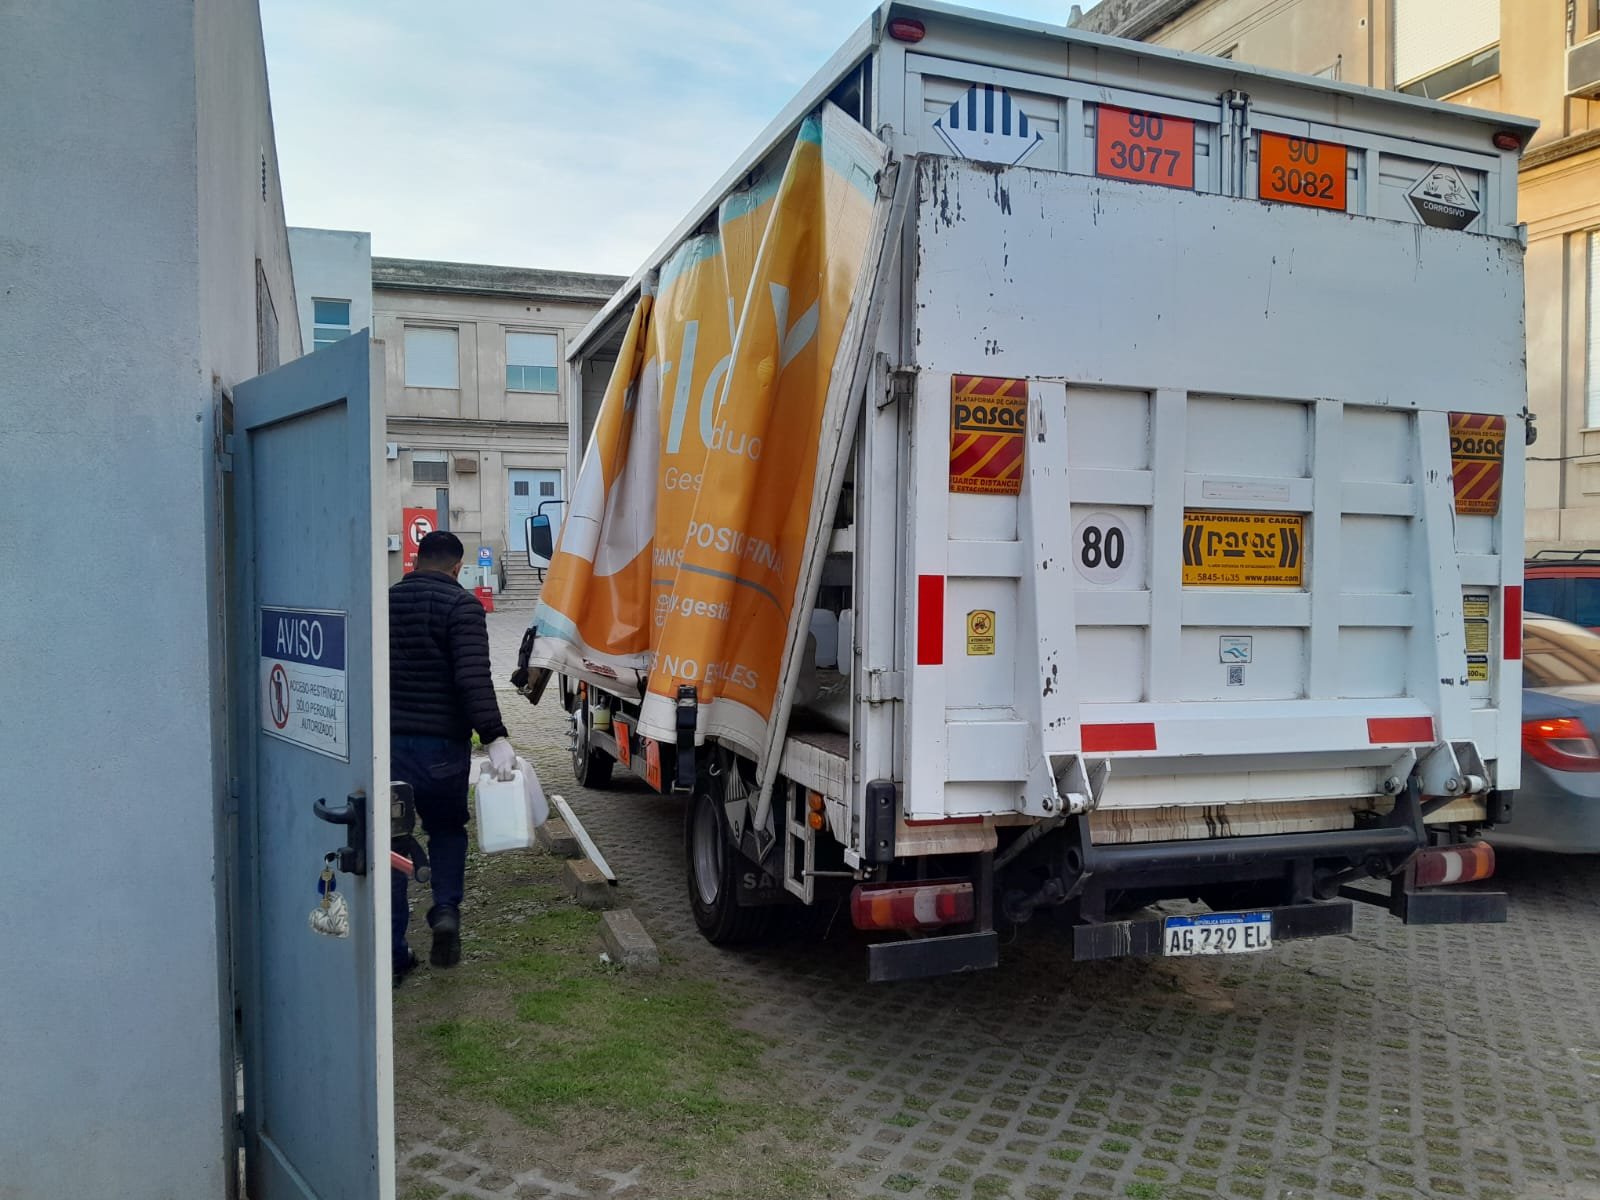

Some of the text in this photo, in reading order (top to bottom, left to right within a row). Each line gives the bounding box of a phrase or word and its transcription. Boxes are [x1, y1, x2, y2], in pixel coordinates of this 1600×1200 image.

[1128, 112, 1164, 141] 90
[1110, 140, 1181, 177] 3077
[1287, 138, 1320, 166] 90
[1271, 165, 1335, 200] 3082
[1423, 201, 1465, 218] CORROSIVO
[955, 395, 995, 404] PLATAFORMA
[954, 404, 1025, 430] pasac
[1254, 516, 1266, 524] DE
[1268, 517, 1300, 525] CARGA
[1081, 525, 1125, 569] 80
[276, 616, 324, 661] AVISO
[662, 654, 698, 681] NO
[301, 717, 334, 738] AUTORIZADO
[1170, 925, 1268, 953] AG 729 EL
